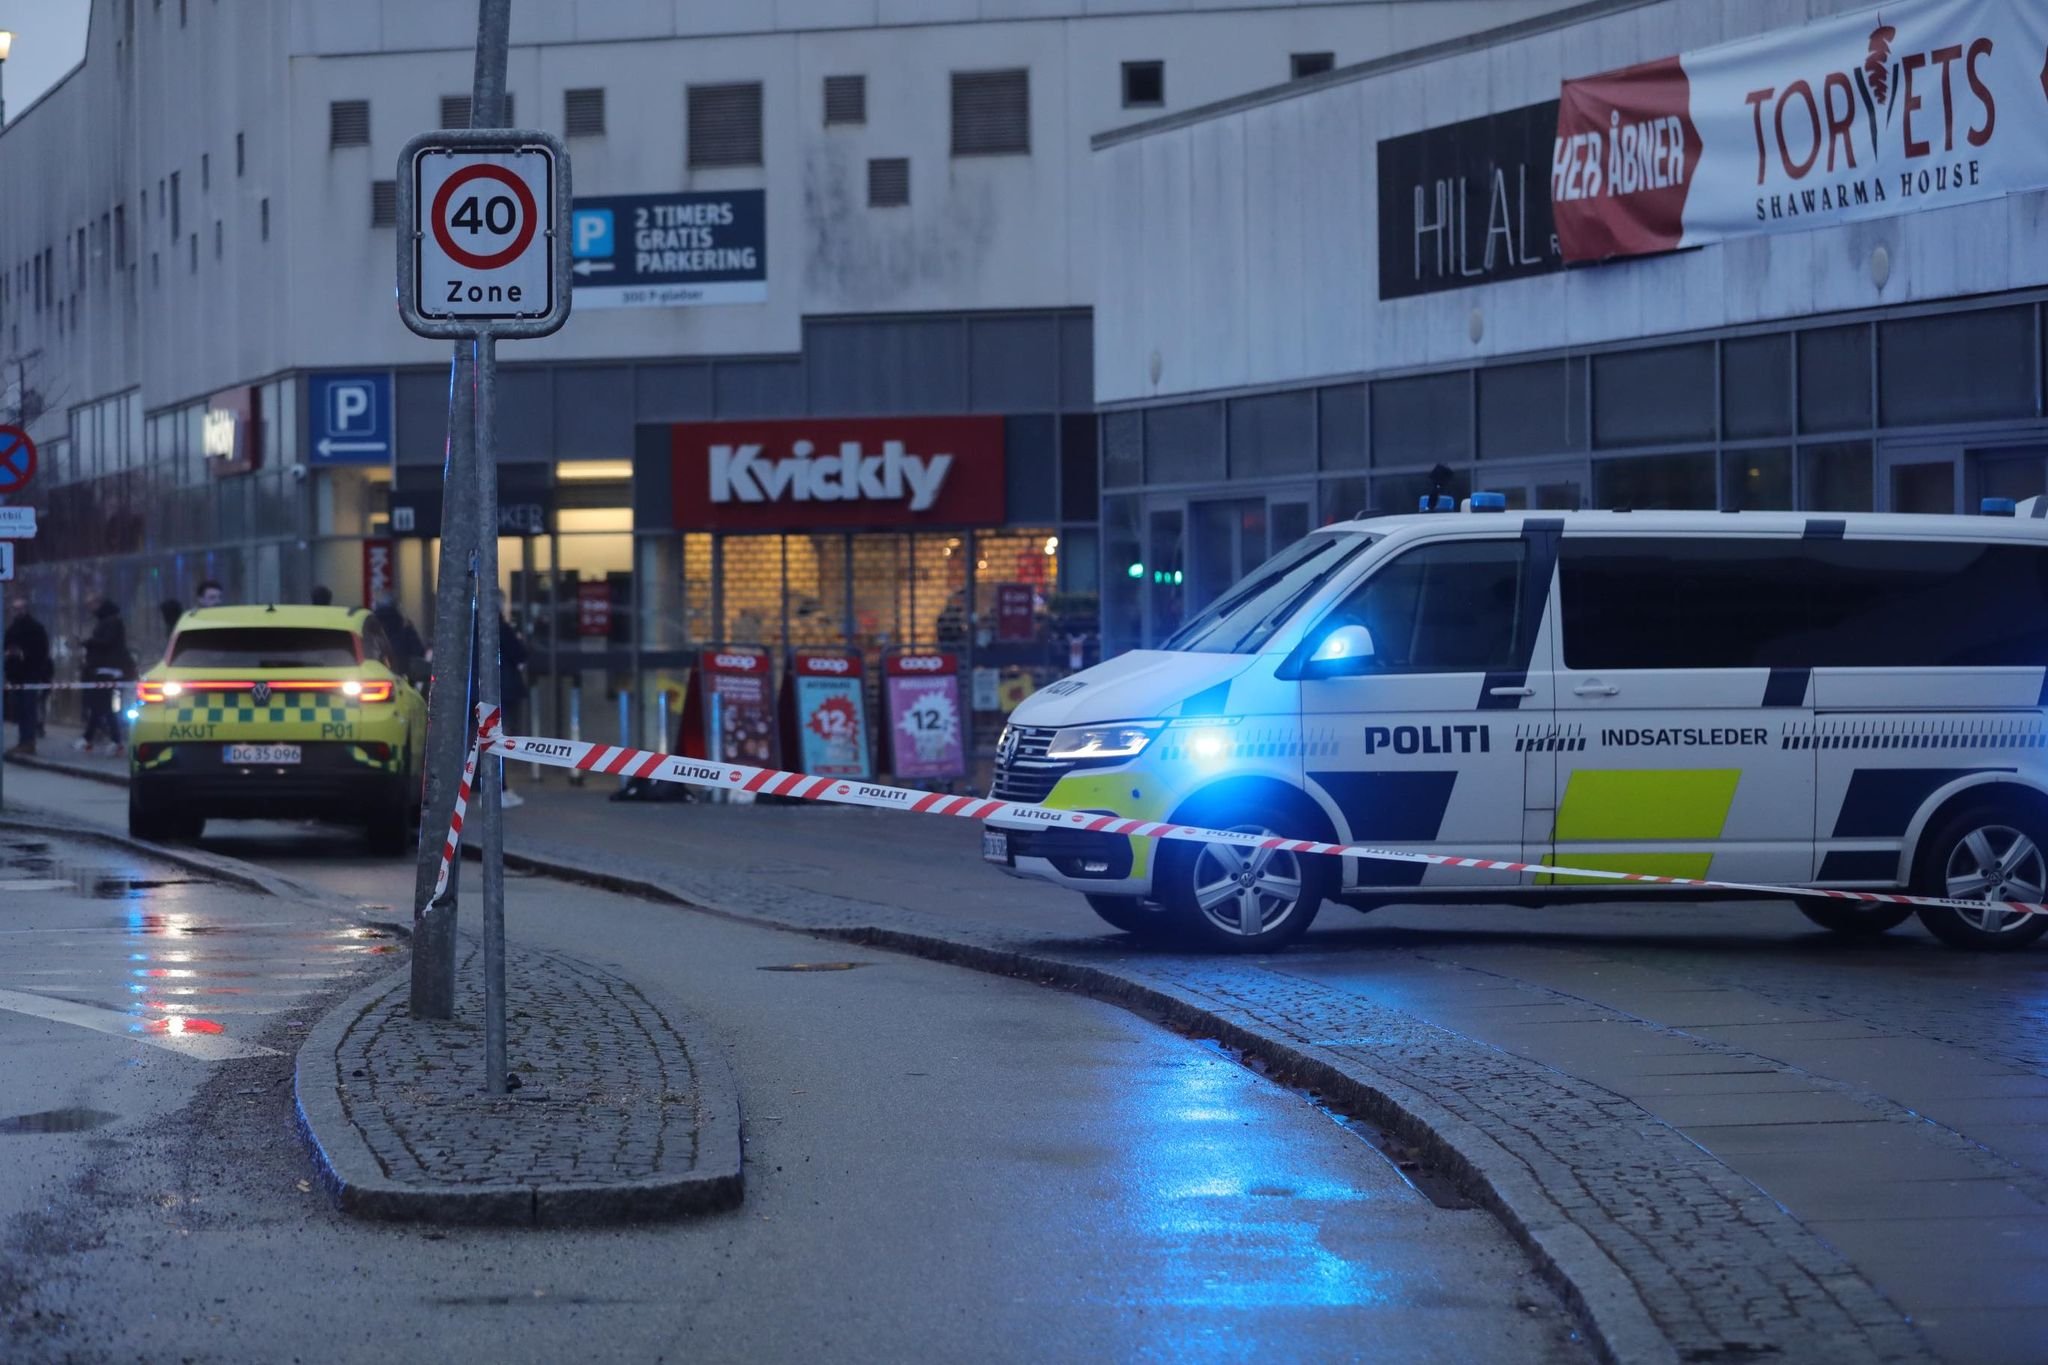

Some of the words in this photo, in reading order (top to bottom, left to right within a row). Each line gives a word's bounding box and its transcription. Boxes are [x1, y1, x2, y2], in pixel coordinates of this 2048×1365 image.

[1745, 37, 1996, 185] TORVETS
[1551, 131, 1602, 202] HER
[1607, 109, 1685, 197] ÅBNER
[1756, 178, 1886, 221] SHAWARMA
[1901, 160, 1979, 197] HOUSE
[452, 196, 516, 235] 40
[635, 208, 649, 229] 2
[654, 203, 734, 228] TIMERS
[1414, 163, 1542, 279] HILAL
[578, 216, 606, 252] P
[635, 227, 713, 251] GRATIS
[635, 248, 758, 275] PARKERING
[447, 281, 522, 303] Zone
[337, 387, 368, 431] P
[708, 440, 954, 511] Kvickly
[715, 654, 757, 670] coop
[807, 658, 848, 673] coop
[900, 657, 943, 672] coop
[168, 724, 217, 739] AKUT
[321, 723, 353, 738] P01
[1365, 725, 1490, 755] POLITI
[1601, 728, 1768, 747] INDSATSLEDER
[255, 747, 271, 761] 35
[273, 747, 300, 761] 096
[525, 742, 572, 757] POLITI
[672, 765, 721, 780] POLITI
[858, 786, 907, 801] POLITI
[1013, 808, 1062, 821] POLITI
